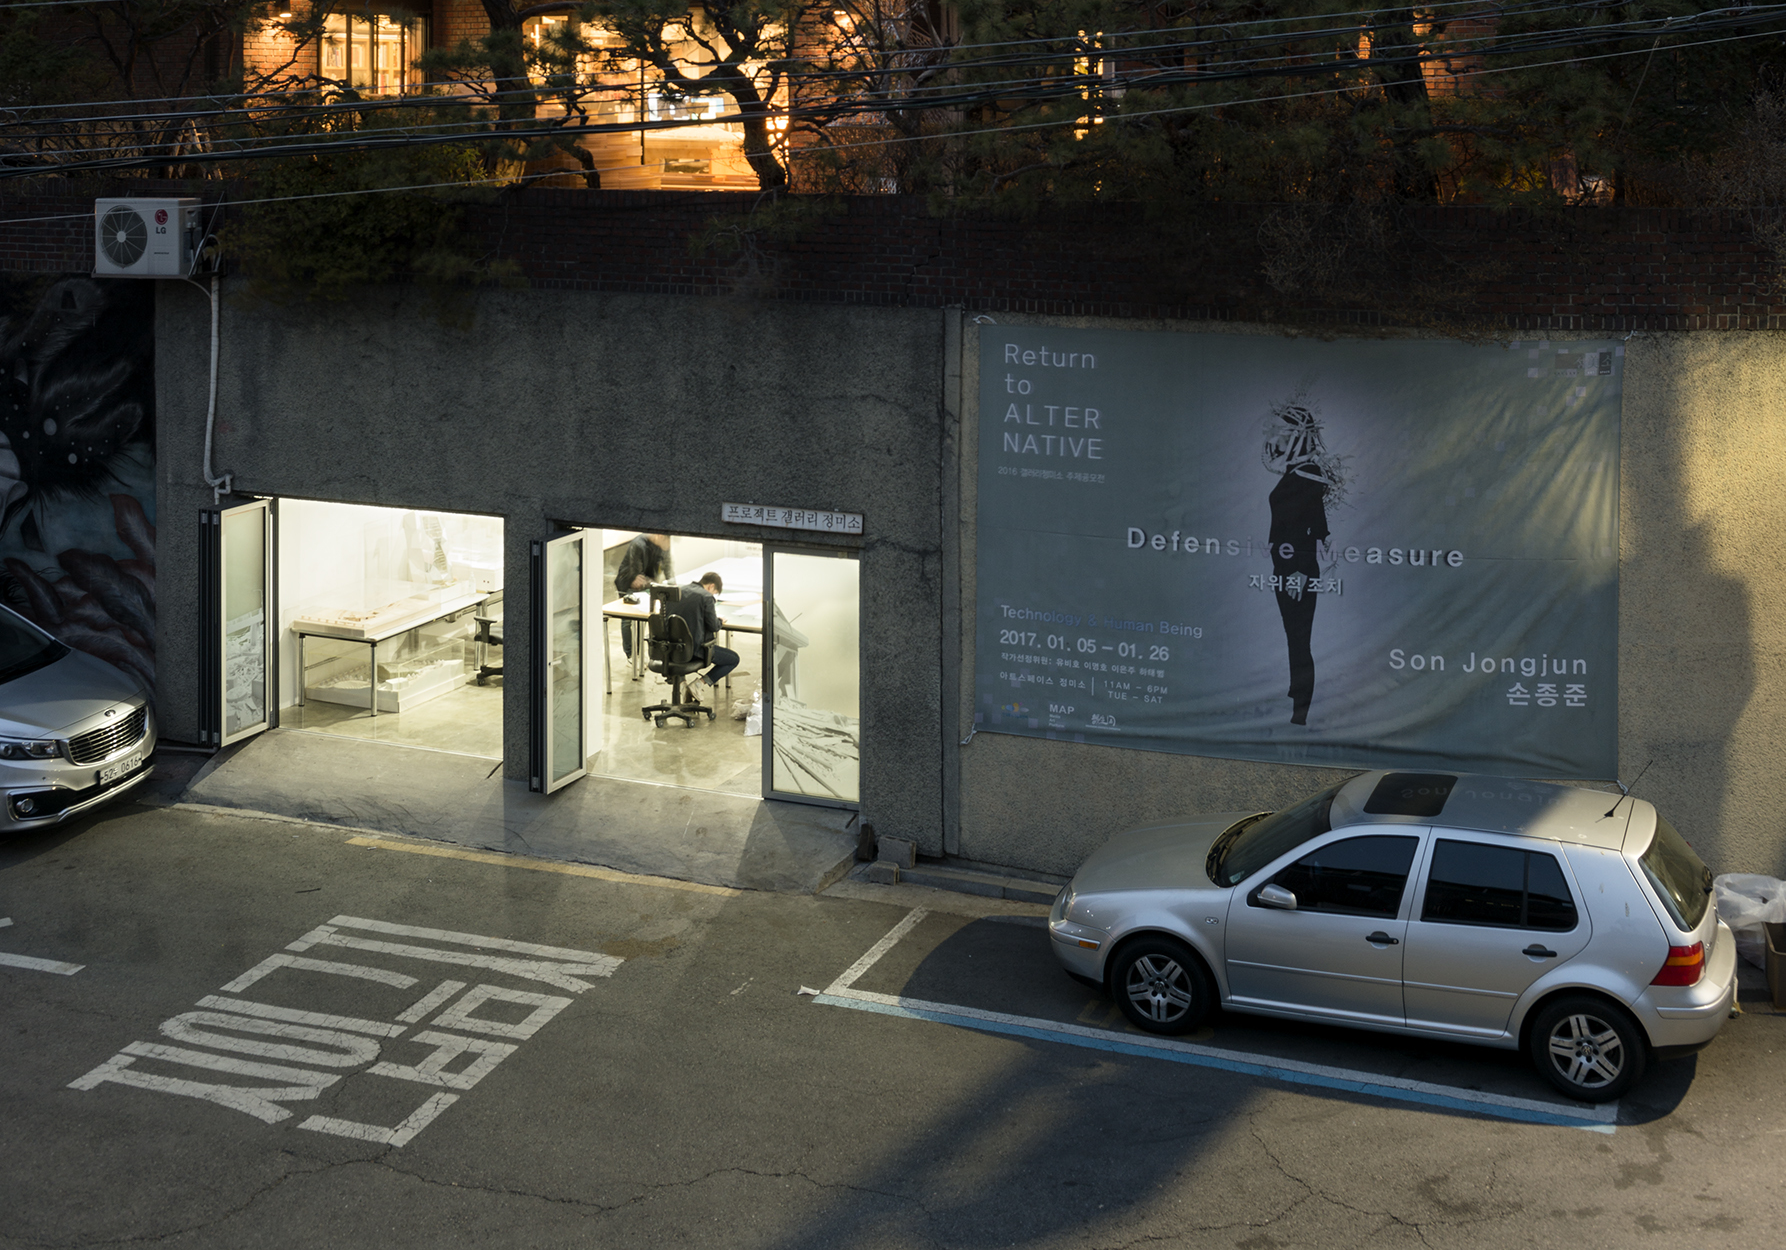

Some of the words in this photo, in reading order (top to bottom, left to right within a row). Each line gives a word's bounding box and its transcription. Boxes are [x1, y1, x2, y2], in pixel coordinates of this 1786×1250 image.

[1004, 343, 1095, 369] Return
[1004, 373, 1032, 395] to
[1003, 402, 1100, 429] ALTER
[1003, 431, 1104, 460] NATIVE
[997, 466, 1018, 477] 2016
[727, 505, 778, 522] 프로젝트
[781, 510, 818, 527] 갤러리
[822, 513, 861, 530] 정미소
[1126, 526, 1296, 559] Defensive
[1315, 539, 1465, 568] Measure
[1248, 573, 1301, 593] 자위적
[1306, 577, 1344, 596] 조치
[1000, 604, 1082, 627] Technology
[1087, 613, 1098, 627] &
[1103, 615, 1155, 633] Human
[1159, 620, 1204, 640] Being
[999, 629, 1042, 648] 2017.
[1047, 634, 1072, 652] 01.
[1076, 637, 1097, 654] 05
[1118, 642, 1144, 660] 01.
[1149, 644, 1171, 662] 26
[1388, 648, 1446, 671] Son
[1462, 651, 1588, 677] Jongjun
[1059, 677, 1086, 690] 정미소
[1103, 680, 1131, 691] 11AM
[1147, 684, 1168, 695] 6PM
[1506, 681, 1588, 708] 손종준
[1048, 703, 1075, 715] MAP
[1107, 690, 1128, 701] TUE
[1144, 694, 1164, 704] SAT
[121, 756, 139, 773] 0616
[65, 914, 627, 1148] 진입금지
